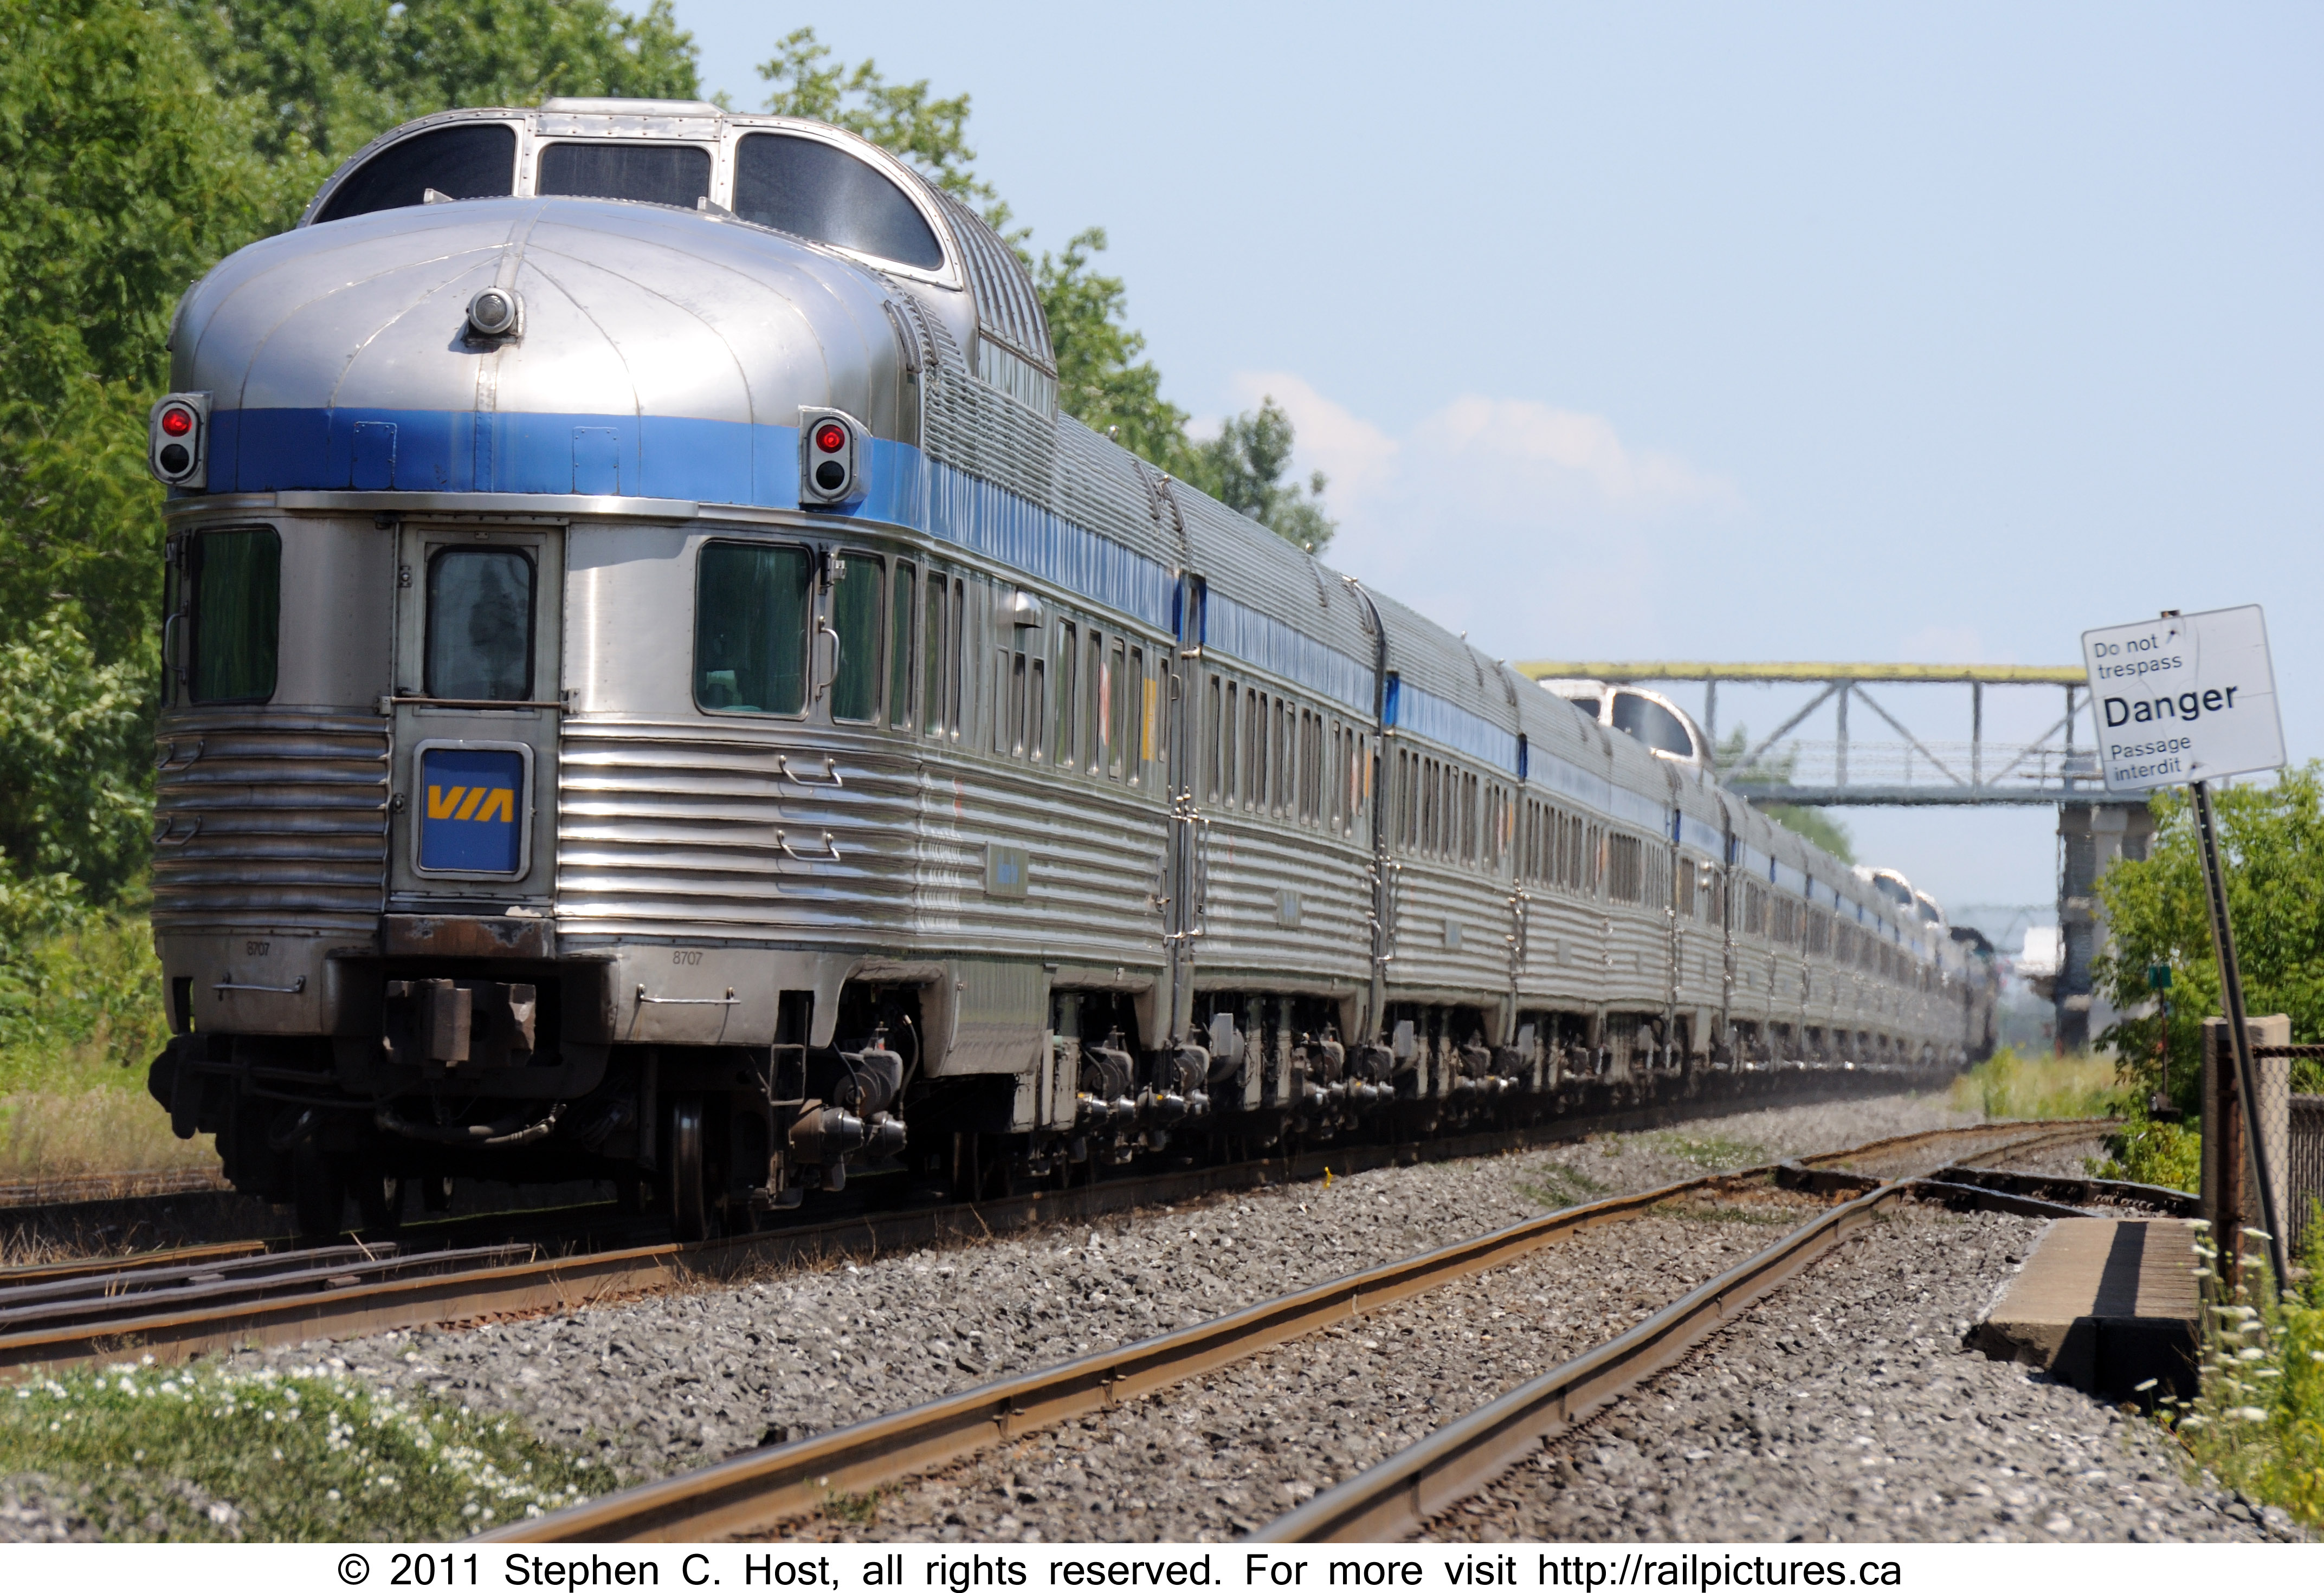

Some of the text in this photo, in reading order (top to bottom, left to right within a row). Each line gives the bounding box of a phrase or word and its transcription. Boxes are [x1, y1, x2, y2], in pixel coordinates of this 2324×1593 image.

[2094, 633, 2159, 658] Do not
[2099, 656, 2183, 679] trespass
[2104, 685, 2238, 728] Danger
[2112, 737, 2192, 759] Passage
[2115, 758, 2182, 781] interdit
[428, 785, 514, 822] VIA
[247, 941, 270, 956] 8707
[673, 950, 703, 966] 8707
